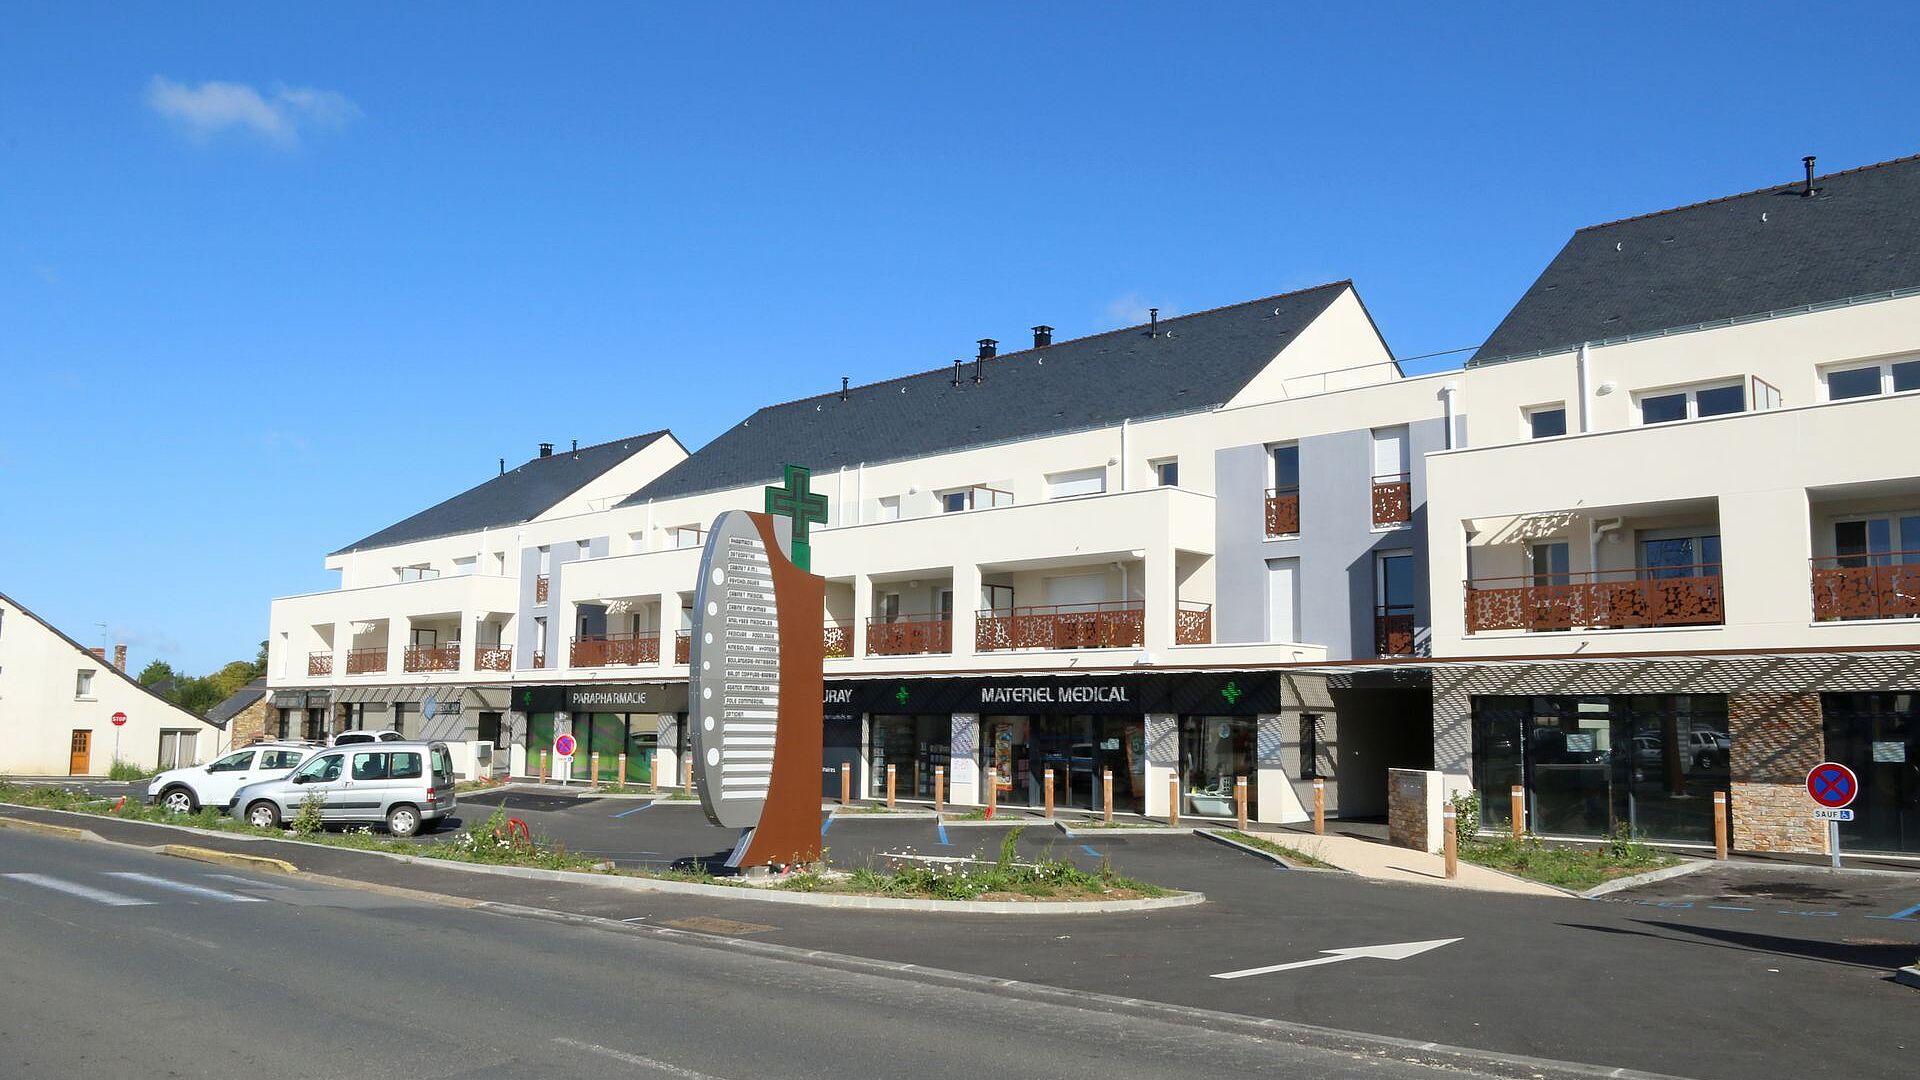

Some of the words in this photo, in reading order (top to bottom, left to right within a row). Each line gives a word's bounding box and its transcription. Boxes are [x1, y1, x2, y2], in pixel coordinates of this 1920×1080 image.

[572, 692, 647, 704] PARAPHARMACIE
[981, 687, 1055, 703] MATERIEL
[1058, 686, 1130, 702] MEDICAL
[1815, 810, 1838, 818] SAUF
